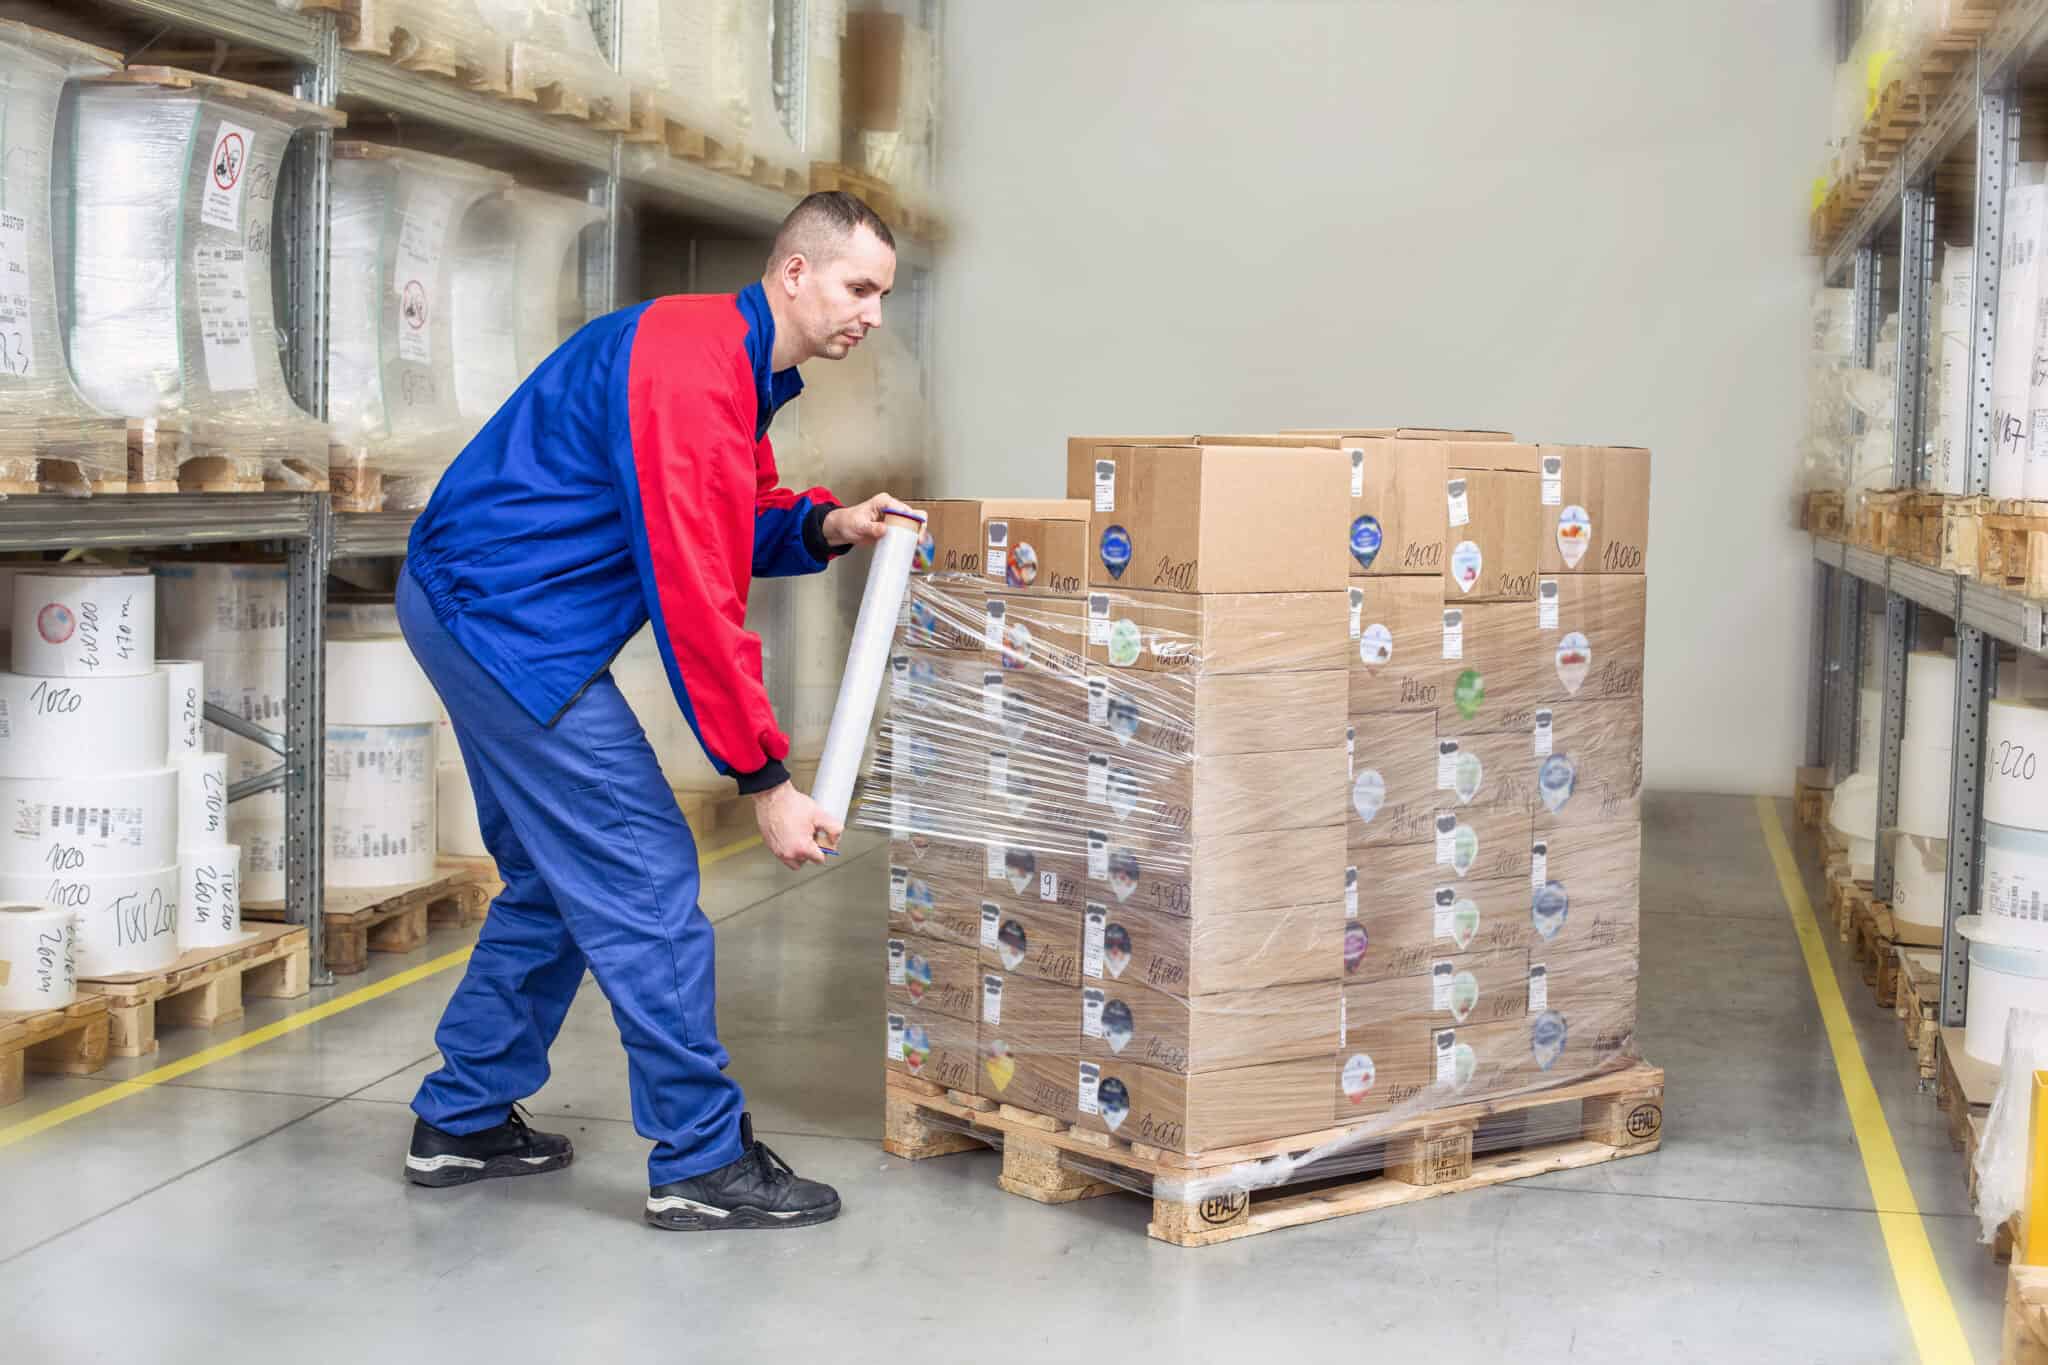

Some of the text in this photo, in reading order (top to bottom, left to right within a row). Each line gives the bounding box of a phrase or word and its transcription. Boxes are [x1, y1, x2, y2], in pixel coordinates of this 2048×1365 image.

[30, 680, 82, 715] 1020
[46, 842, 85, 872] 1020
[1632, 1111, 1657, 1132] EPAL
[1208, 1191, 1239, 1217] EPAL
